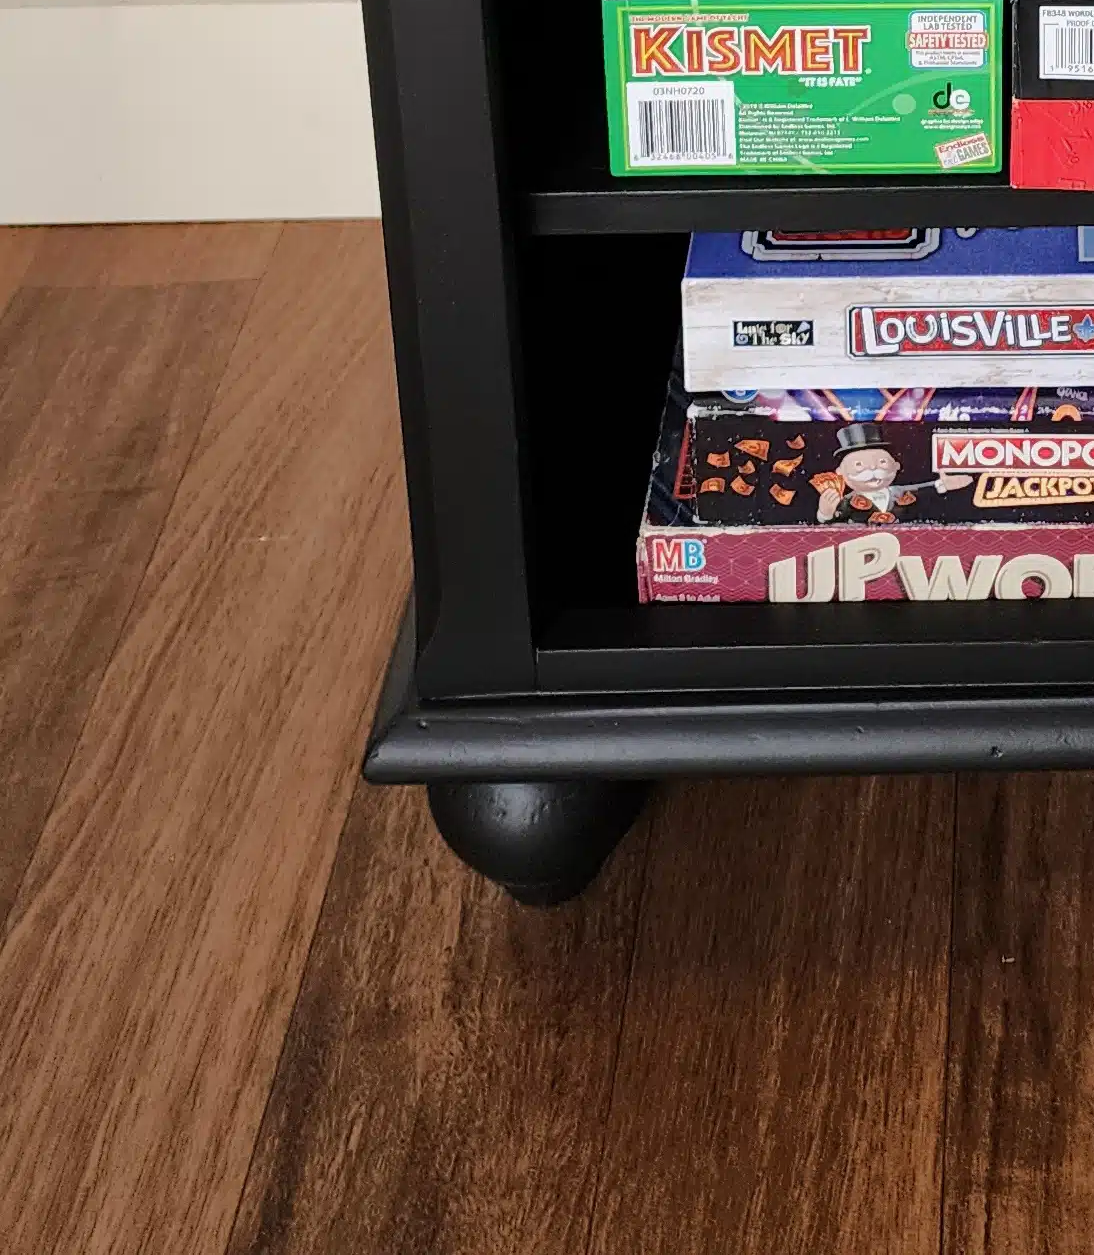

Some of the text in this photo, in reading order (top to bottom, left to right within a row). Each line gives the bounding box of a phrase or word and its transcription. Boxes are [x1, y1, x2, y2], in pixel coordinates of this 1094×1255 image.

[917, 15, 978, 23] INDEPENDENT
[631, 25, 871, 75] KISMET
[908, 33, 987, 48] SAFETY TESTED
[652, 538, 707, 573] MB
